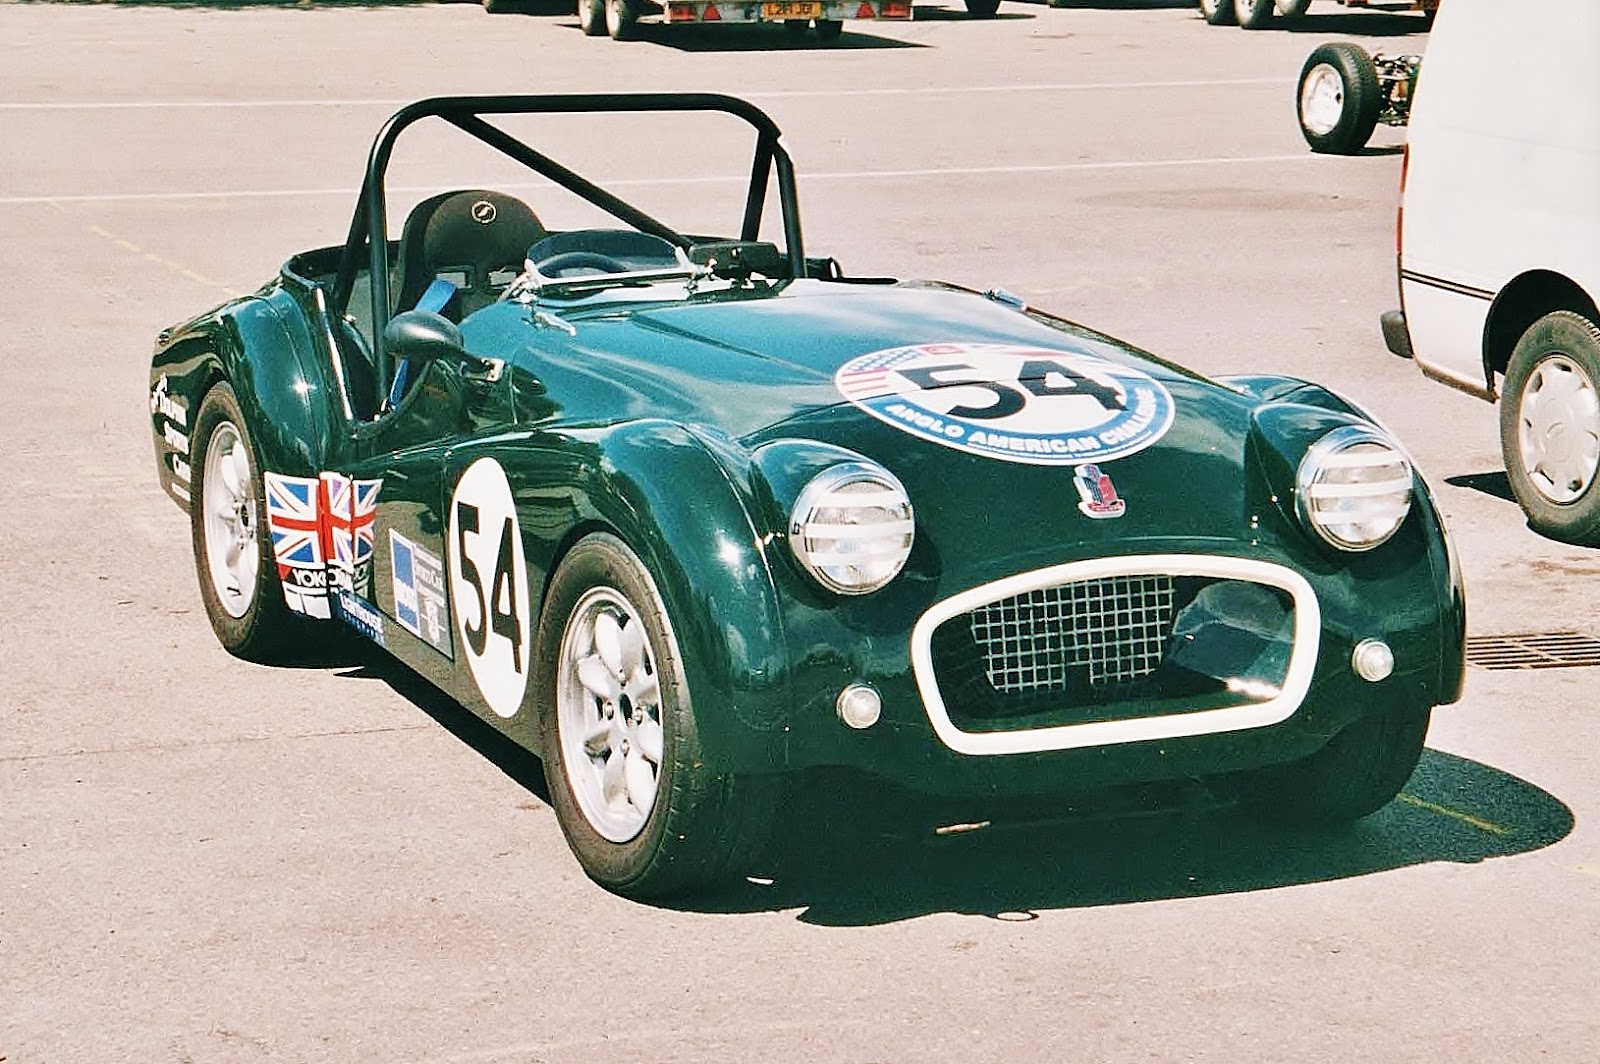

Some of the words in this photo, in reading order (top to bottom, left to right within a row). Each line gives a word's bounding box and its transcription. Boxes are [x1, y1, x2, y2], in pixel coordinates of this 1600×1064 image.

[895, 360, 1129, 420] 54
[885, 403, 965, 437] ANGLO
[967, 430, 1101, 454] AMERICAN
[457, 500, 523, 675] 54
